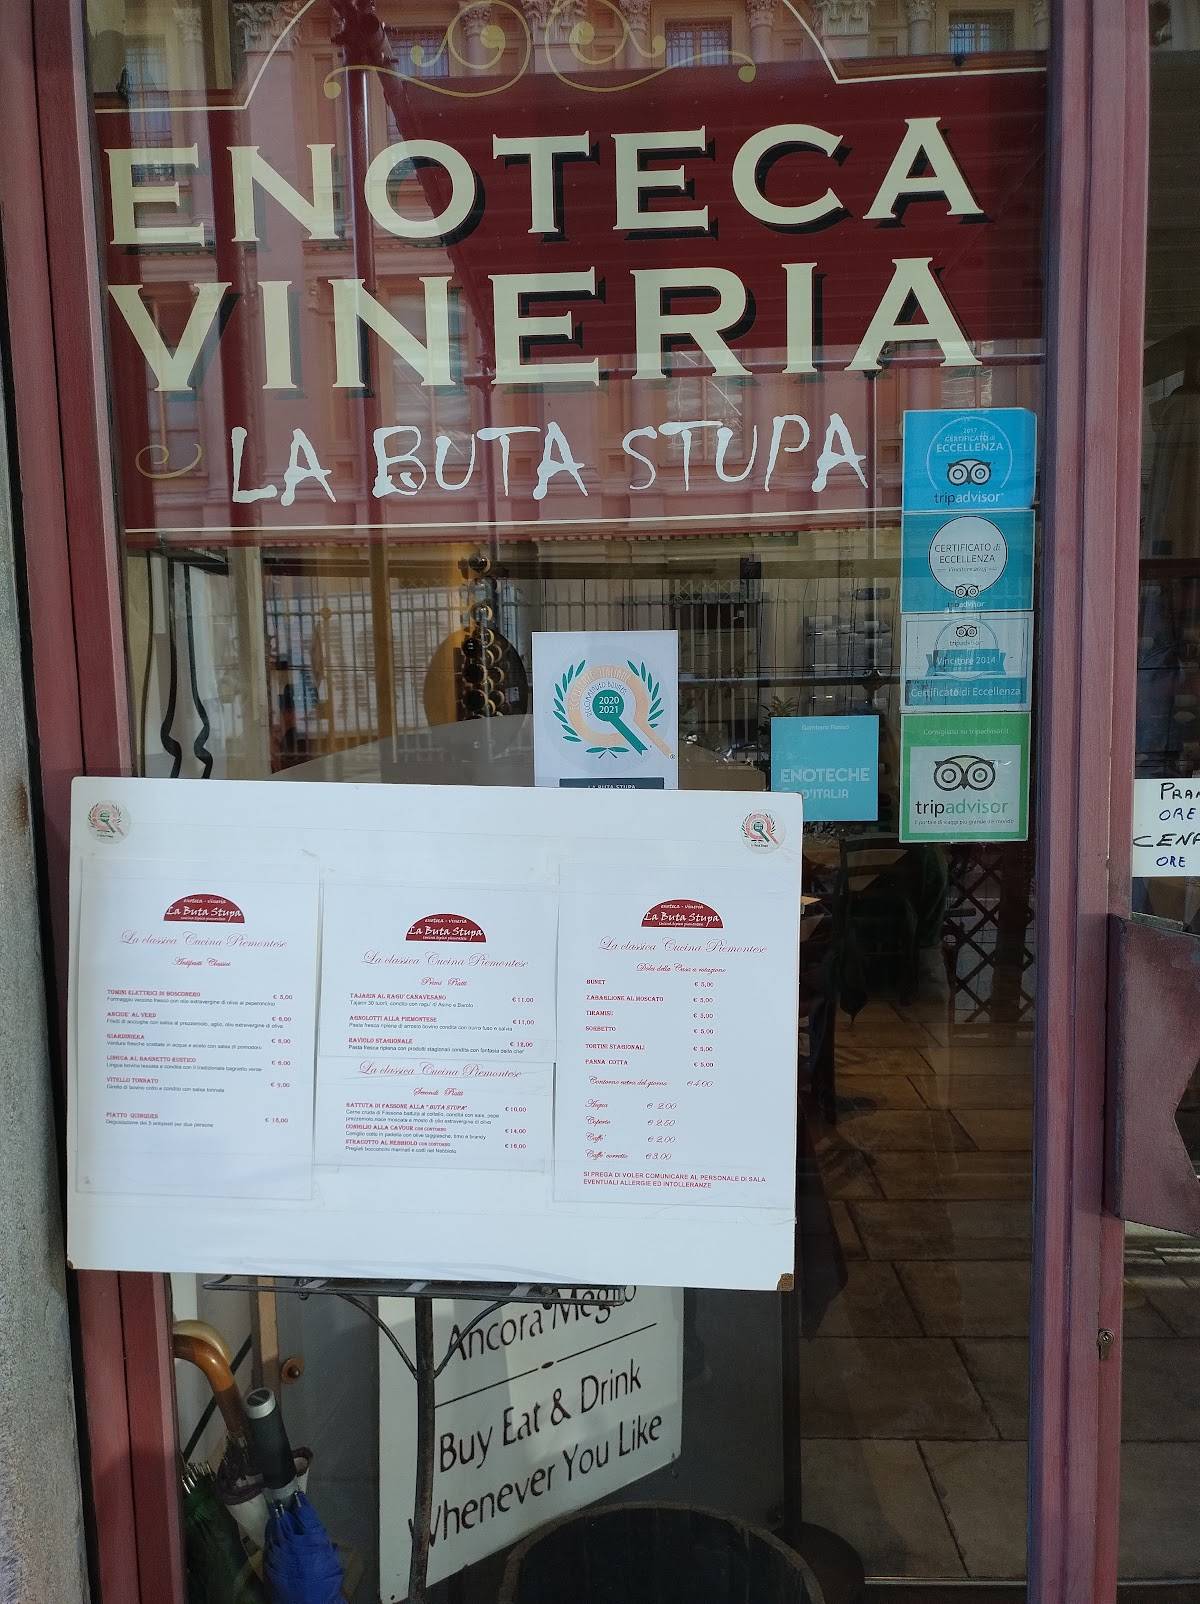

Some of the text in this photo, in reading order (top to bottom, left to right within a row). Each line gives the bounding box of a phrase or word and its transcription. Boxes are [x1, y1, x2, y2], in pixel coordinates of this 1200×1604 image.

[103, 115, 985, 247] ENOTECA
[107, 256, 983, 392] VINERIA
[944, 435, 988, 443] CERTIFICATO
[936, 442, 1004, 453] ECCELLENZA
[231, 412, 869, 507] LA BUTA STUPA
[934, 490, 1001, 509] tripadvisor
[935, 543, 991, 553] CERTIFICATO
[939, 555, 996, 565] ECCELLENZA
[976, 656, 997, 665] 2014
[599, 696, 620, 705] 2020
[911, 687, 1021, 698] Certificato di Eccellenza
[599, 705, 619, 714] 2021
[780, 767, 871, 783] ENOTECHE
[916, 799, 1009, 818] tripadvisor
[1159, 807, 1197, 821] ORE
[1156, 856, 1187, 868] ORE
[166, 905, 181, 915] La
[183, 905, 209, 915] Buta
[210, 907, 242, 921] Stupa
[644, 912, 659, 921] La
[661, 912, 686, 921] Buta
[688, 913, 720, 927] Stupa
[182, 930, 223, 946] Cucina
[226, 933, 288, 948] Piemontese
[408, 926, 423, 935] La
[424, 926, 450, 936] Buta
[452, 926, 484, 940] Stupa
[600, 936, 767, 953] La classica Cucina Piemontese
[361, 950, 529, 968] La classica Cucina Piemontese
[359, 1059, 522, 1078] La classica Cucina Piemontese
[700, 1174, 740, 1182] PERSONALE
[449, 1309, 544, 1361] Ancora
[439, 1358, 643, 1473] Buy Eat & Drink
[562, 1439, 609, 1482] You
[618, 1413, 663, 1457] Like
